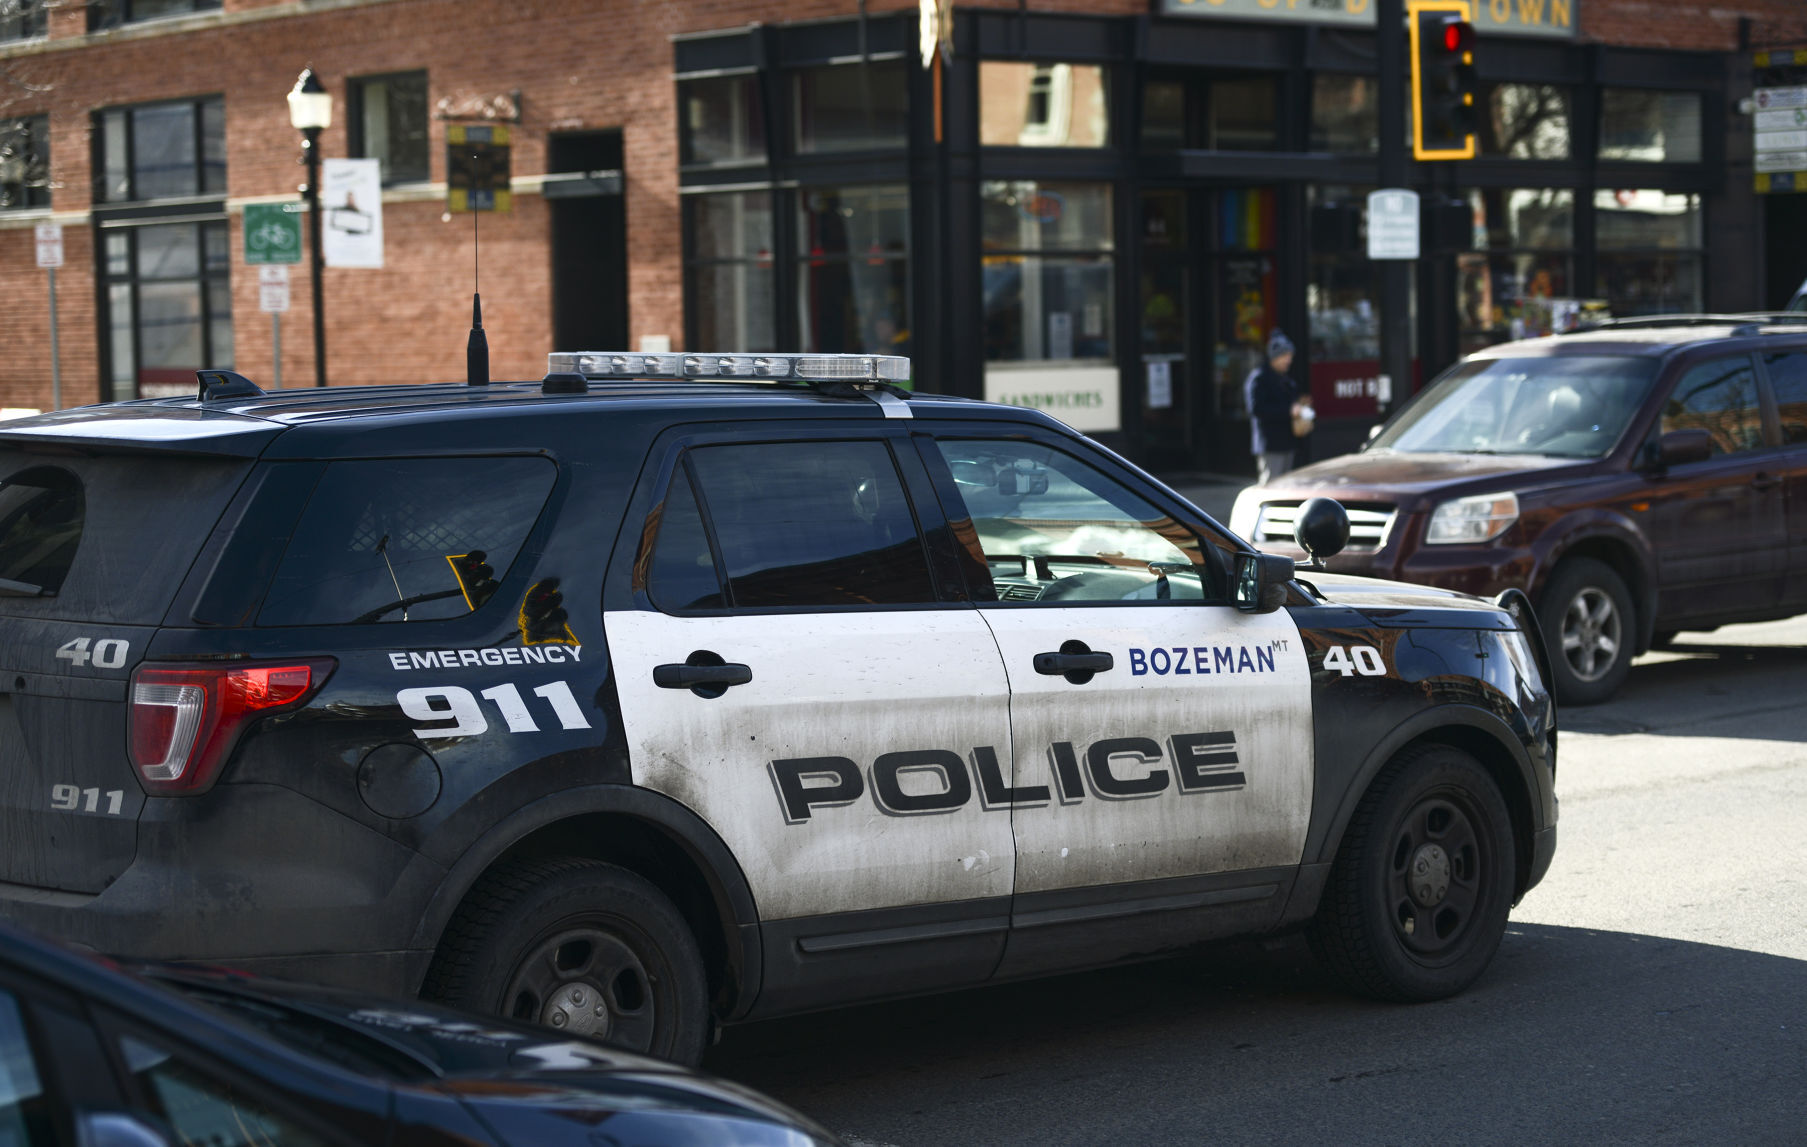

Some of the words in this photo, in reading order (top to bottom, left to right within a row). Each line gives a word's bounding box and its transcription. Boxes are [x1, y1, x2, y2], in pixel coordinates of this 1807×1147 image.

[999, 390, 1103, 408] SANDWICHES
[56, 637, 130, 669] 40
[388, 645, 582, 671] EMERGENCY
[1129, 645, 1276, 676] BOZEMAN
[1271, 639, 1289, 652] MT
[1323, 645, 1388, 677] 40
[396, 680, 593, 740] 911
[766, 730, 1247, 826] POLICE
[51, 784, 124, 815] 911
